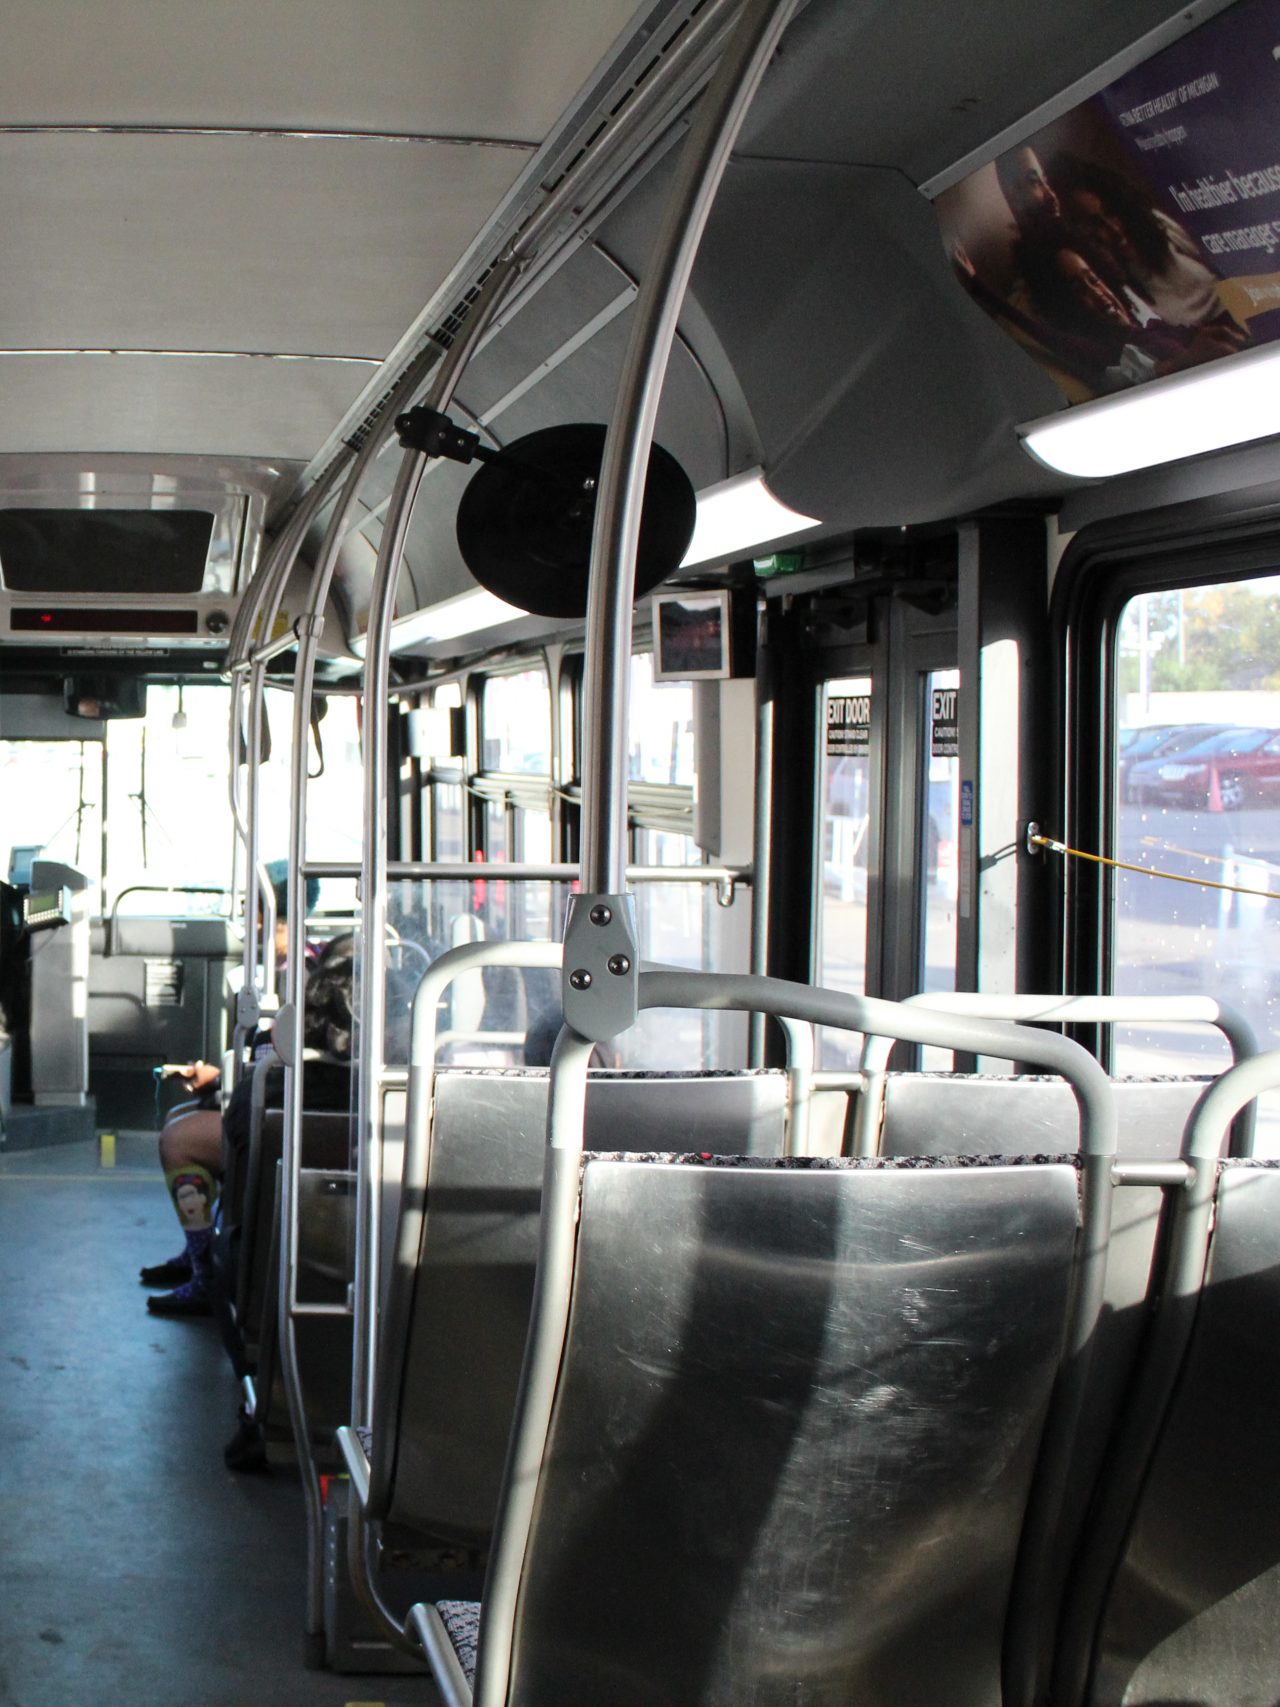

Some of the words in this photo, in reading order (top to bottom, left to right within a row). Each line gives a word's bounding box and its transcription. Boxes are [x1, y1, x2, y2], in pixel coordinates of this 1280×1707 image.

[1132, 101, 1155, 122] BETTER
[1178, 86, 1188, 103] OF
[1187, 72, 1219, 99] MICHIGAN
[1181, 175, 1238, 210] healthier
[1201, 231, 1231, 254] care
[1222, 222, 1279, 253] manager
[827, 698, 845, 724] EXIT
[845, 697, 870, 723] DOOR
[933, 691, 957, 720] EXIT
